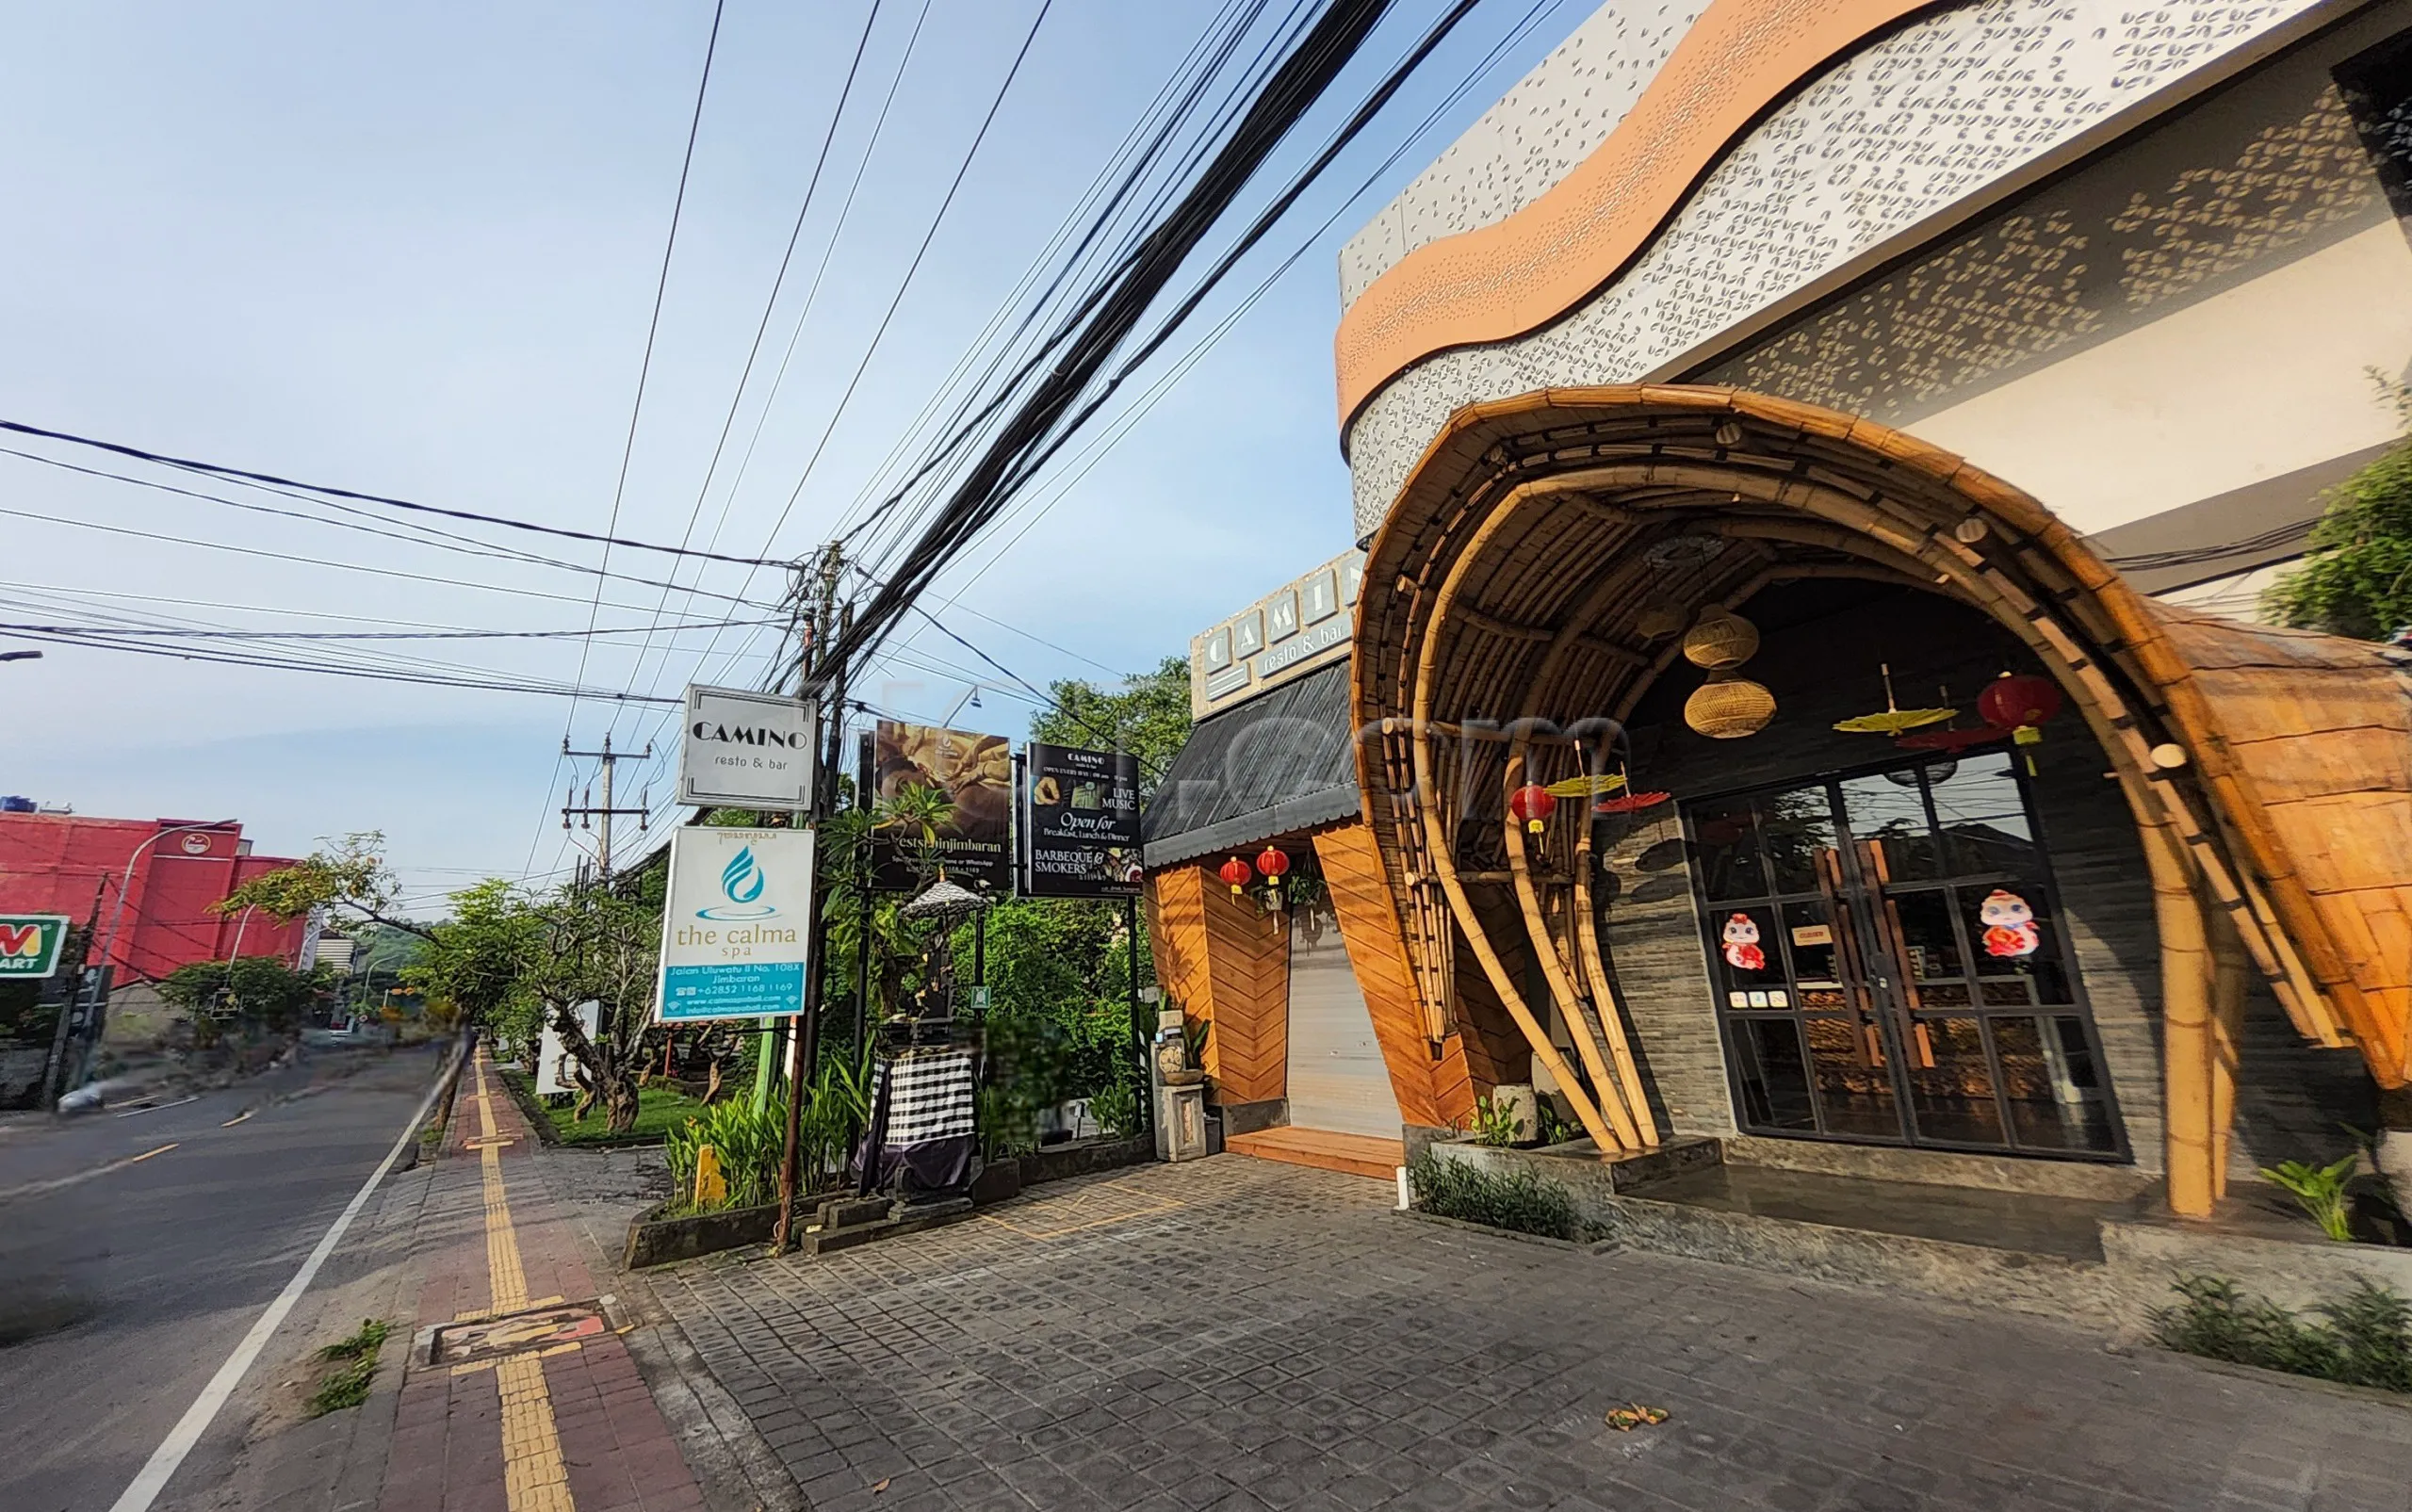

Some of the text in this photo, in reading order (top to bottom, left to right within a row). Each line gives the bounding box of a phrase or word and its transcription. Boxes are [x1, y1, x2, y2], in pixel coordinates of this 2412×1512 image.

[1209, 566, 1362, 663] CAMIN
[1263, 624, 1344, 672] resto & bar
[693, 722, 807, 750] CAMINO
[714, 755, 788, 771] resto & bar
[1067, 754, 1105, 765] CAMINO
[1113, 788, 1135, 800] LIVE
[1101, 798, 1136, 810] MUSIC
[1060, 812, 1116, 832] Open for
[1078, 830, 1100, 839] Lunch
[1035, 849, 1104, 865] BARBEQUE &
[1035, 861, 1087, 874] SMOKERS
[677, 923, 797, 946] the calma
[721, 946, 752, 959] spa
[0, 958, 40, 968] ART
[670, 967, 699, 976] Jalan
[701, 966, 742, 975] Uluwatu
[753, 964, 770, 973] No.
[711, 975, 760, 984] Jimbaran
[741, 984, 765, 993] 1168
[769, 983, 793, 991] 1169
